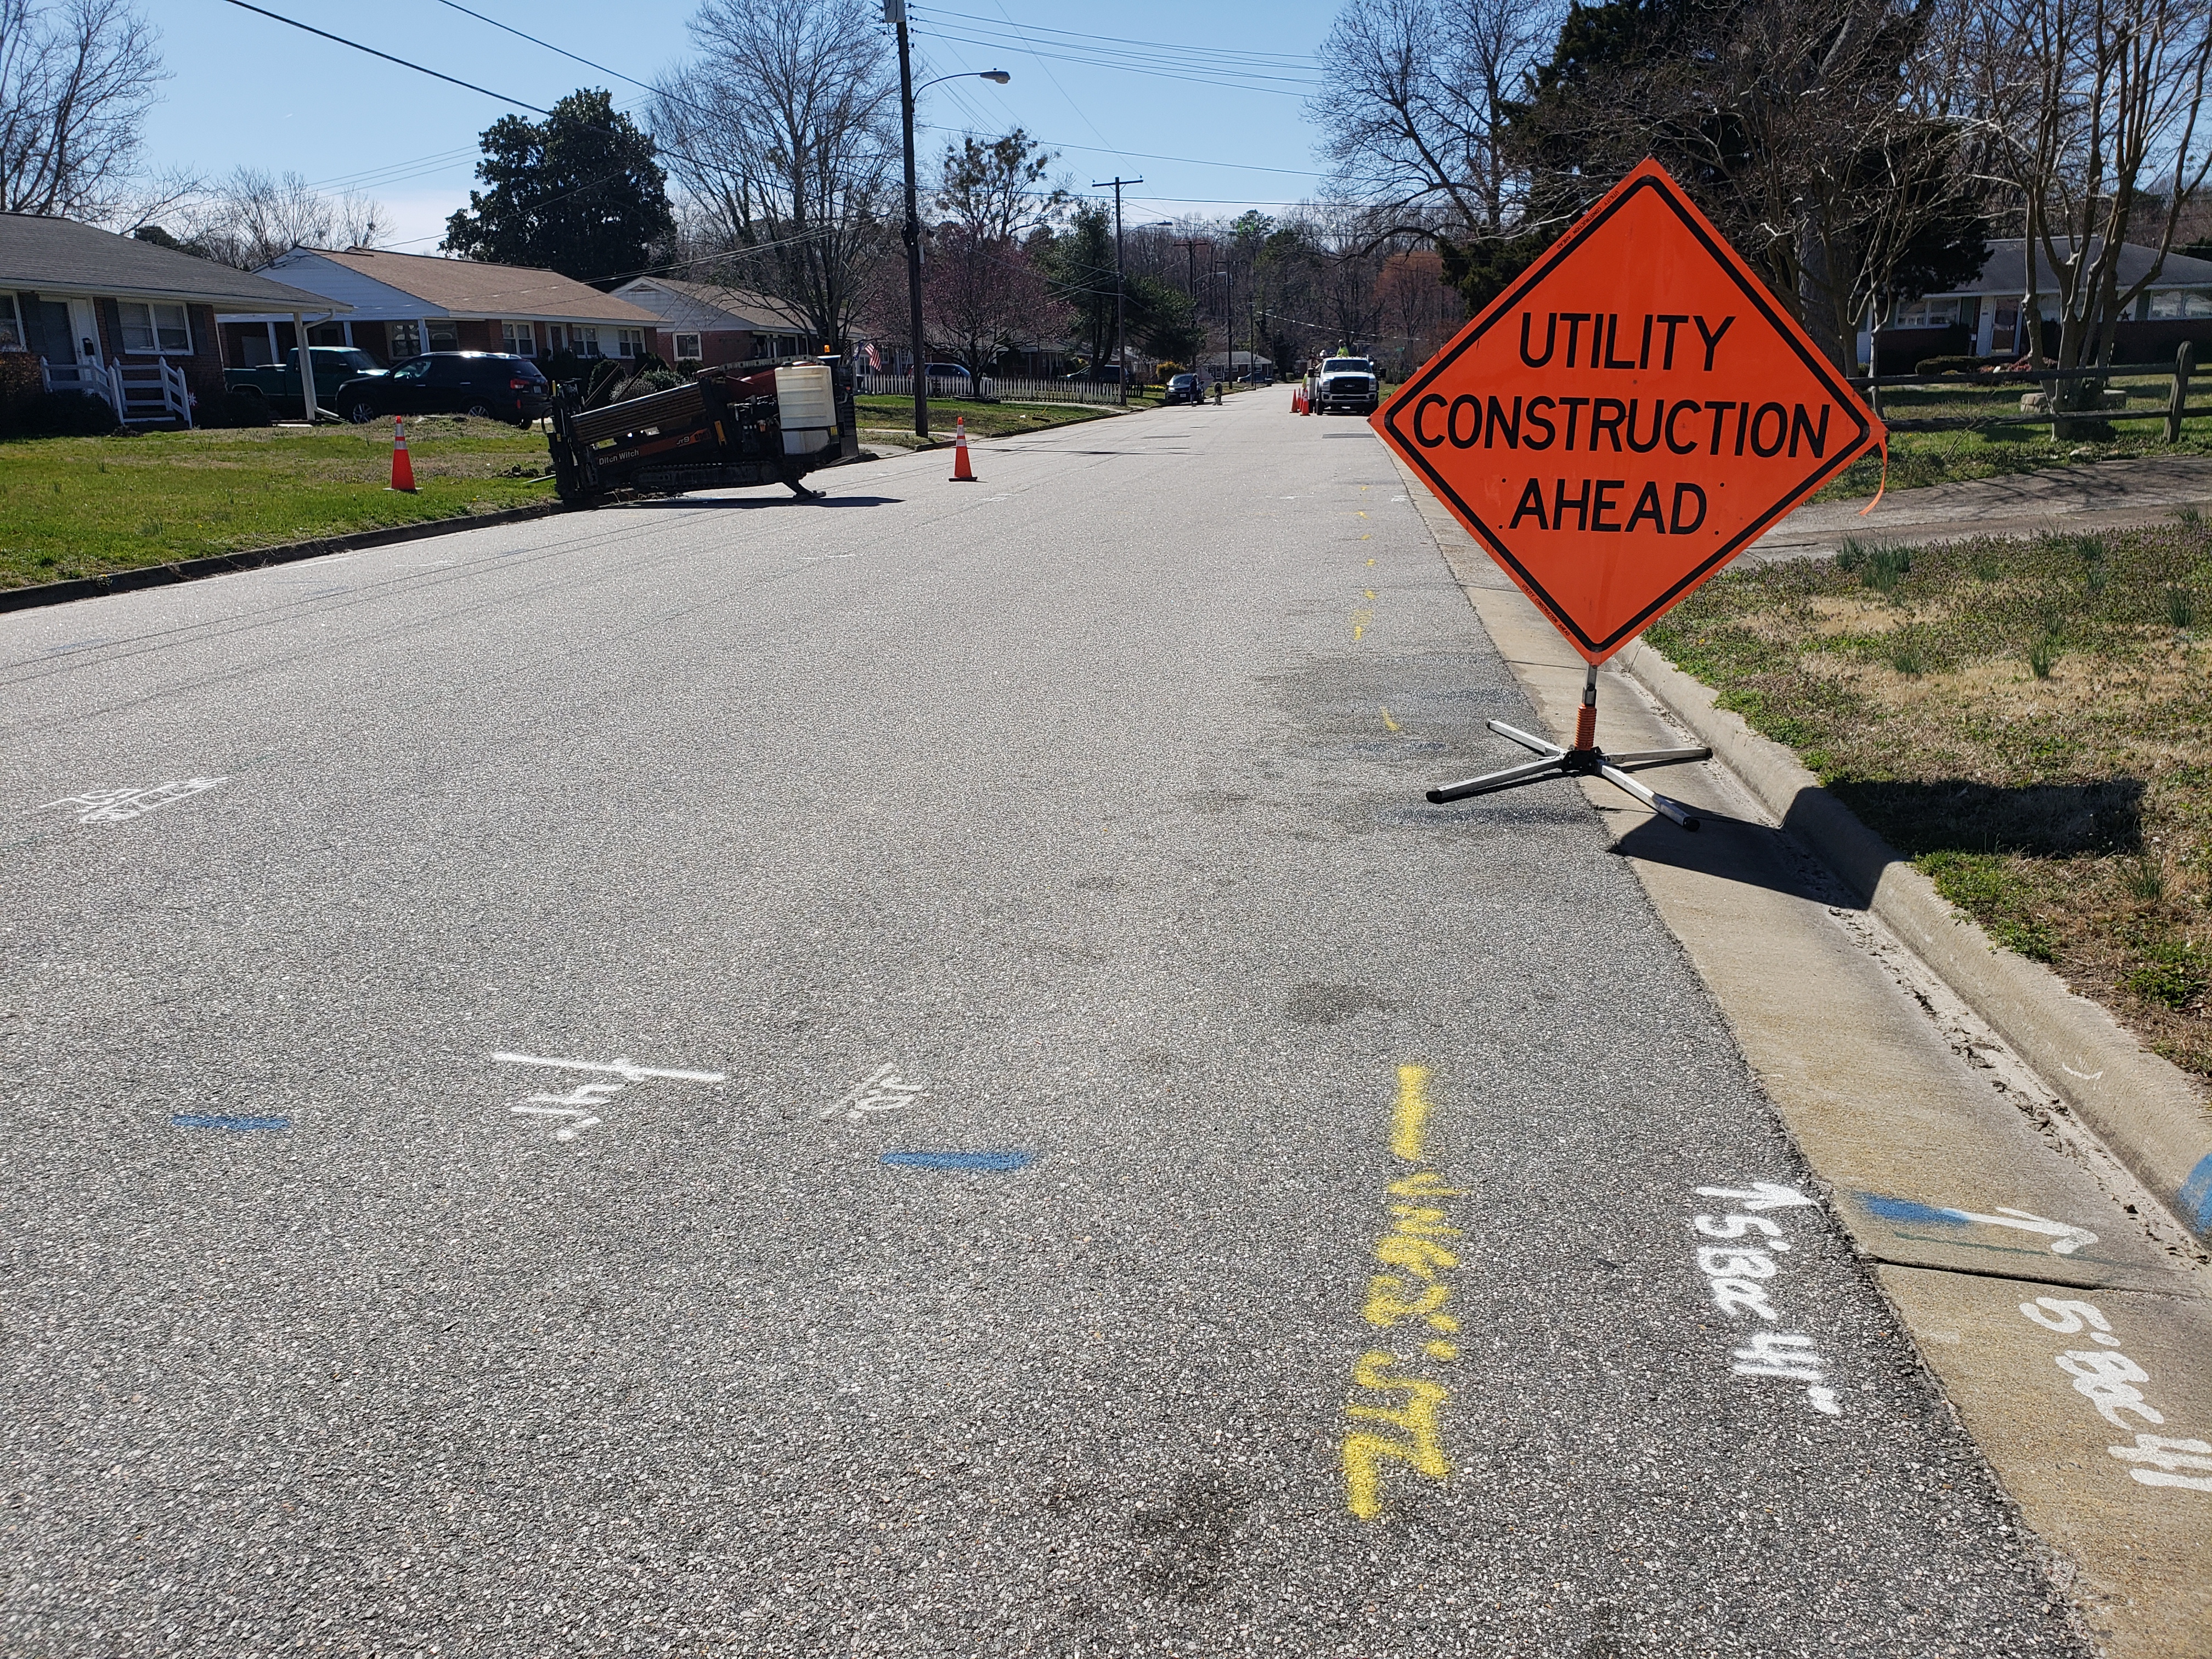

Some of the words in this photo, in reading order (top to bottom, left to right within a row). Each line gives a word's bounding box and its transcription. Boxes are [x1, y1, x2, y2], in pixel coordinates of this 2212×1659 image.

[1604, 190, 1619, 206] UTILITY
[1572, 207, 1602, 235] CONSTRUCTION
[1557, 235, 1571, 249] AHEAD
[1520, 312, 1736, 371] UTILITY
[1413, 393, 1831, 459] CONSTRUCTION
[599, 455, 618, 465] Ditch
[619, 449, 639, 460] Witch
[1508, 477, 1707, 535] AHEAD
[1522, 584, 1534, 597] UTILITY
[1535, 598, 1558, 623] CONSTRUCTION
[1558, 624, 1570, 636] AHEAD
